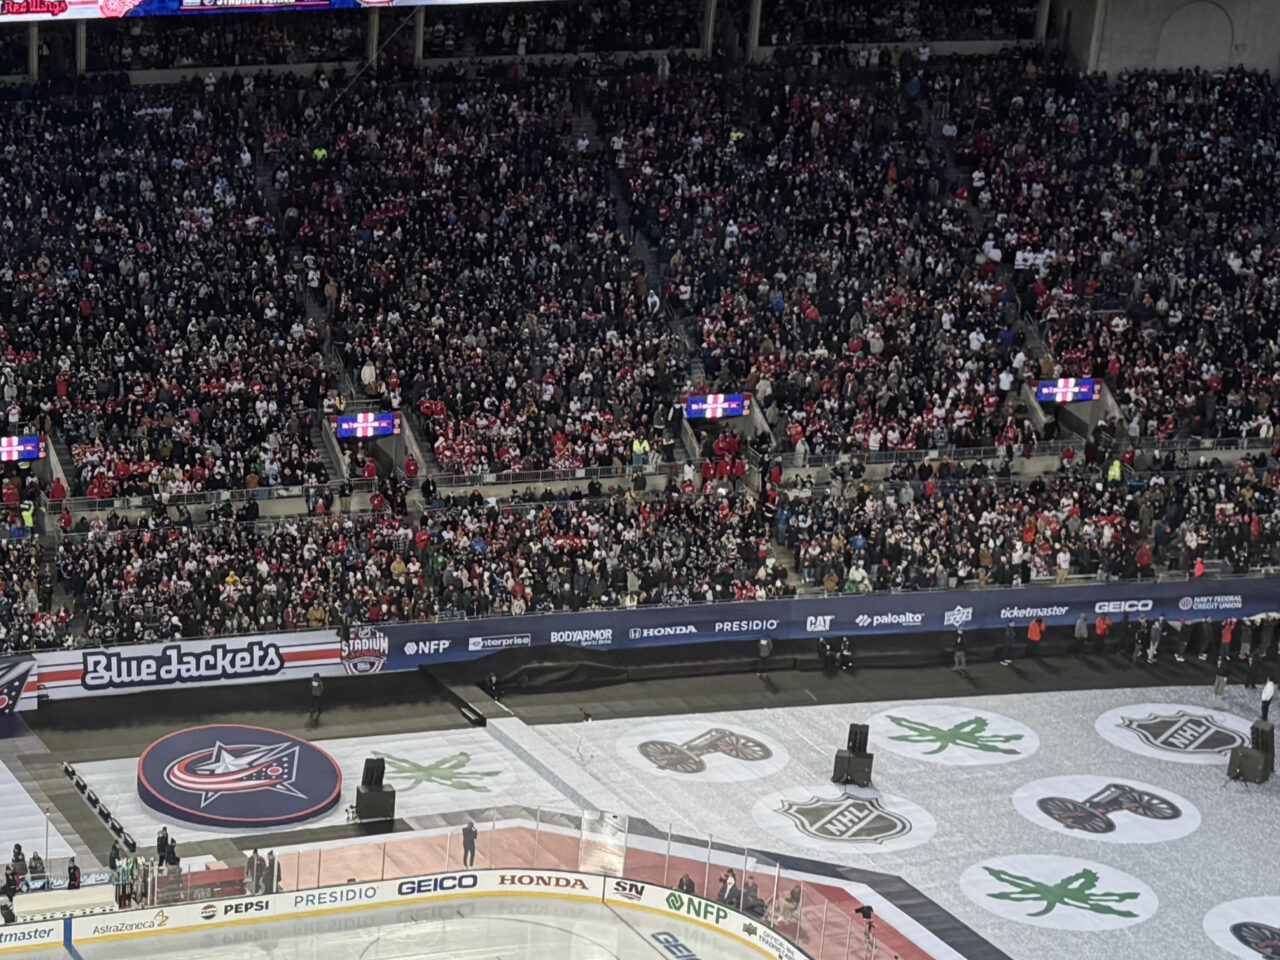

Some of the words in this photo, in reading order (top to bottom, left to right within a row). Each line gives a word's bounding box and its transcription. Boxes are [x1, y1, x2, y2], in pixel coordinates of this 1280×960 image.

[1000, 605, 1068, 619] ticketmaster
[1094, 599, 1153, 613] GEICO
[715, 619, 777, 632] PRESIDIO
[806, 615, 833, 631] CAT
[873, 612, 922, 626] paloalto
[550, 628, 613, 643] BODYARMOR
[642, 625, 697, 637] HONDA
[341, 636, 388, 657] STADIUM
[418, 640, 450, 654] NFP
[85, 654, 157, 686] Blue
[159, 644, 281, 680] Jackets
[1167, 721, 1208, 749] NHL
[823, 806, 870, 837] NHL
[397, 874, 478, 896] GEICO
[498, 875, 589, 890] HONDA
[294, 886, 377, 907] PRESIDIO
[224, 900, 269, 915] PEPSI
[686, 897, 728, 924] NFP
[93, 919, 155, 935] AstraZeneca
